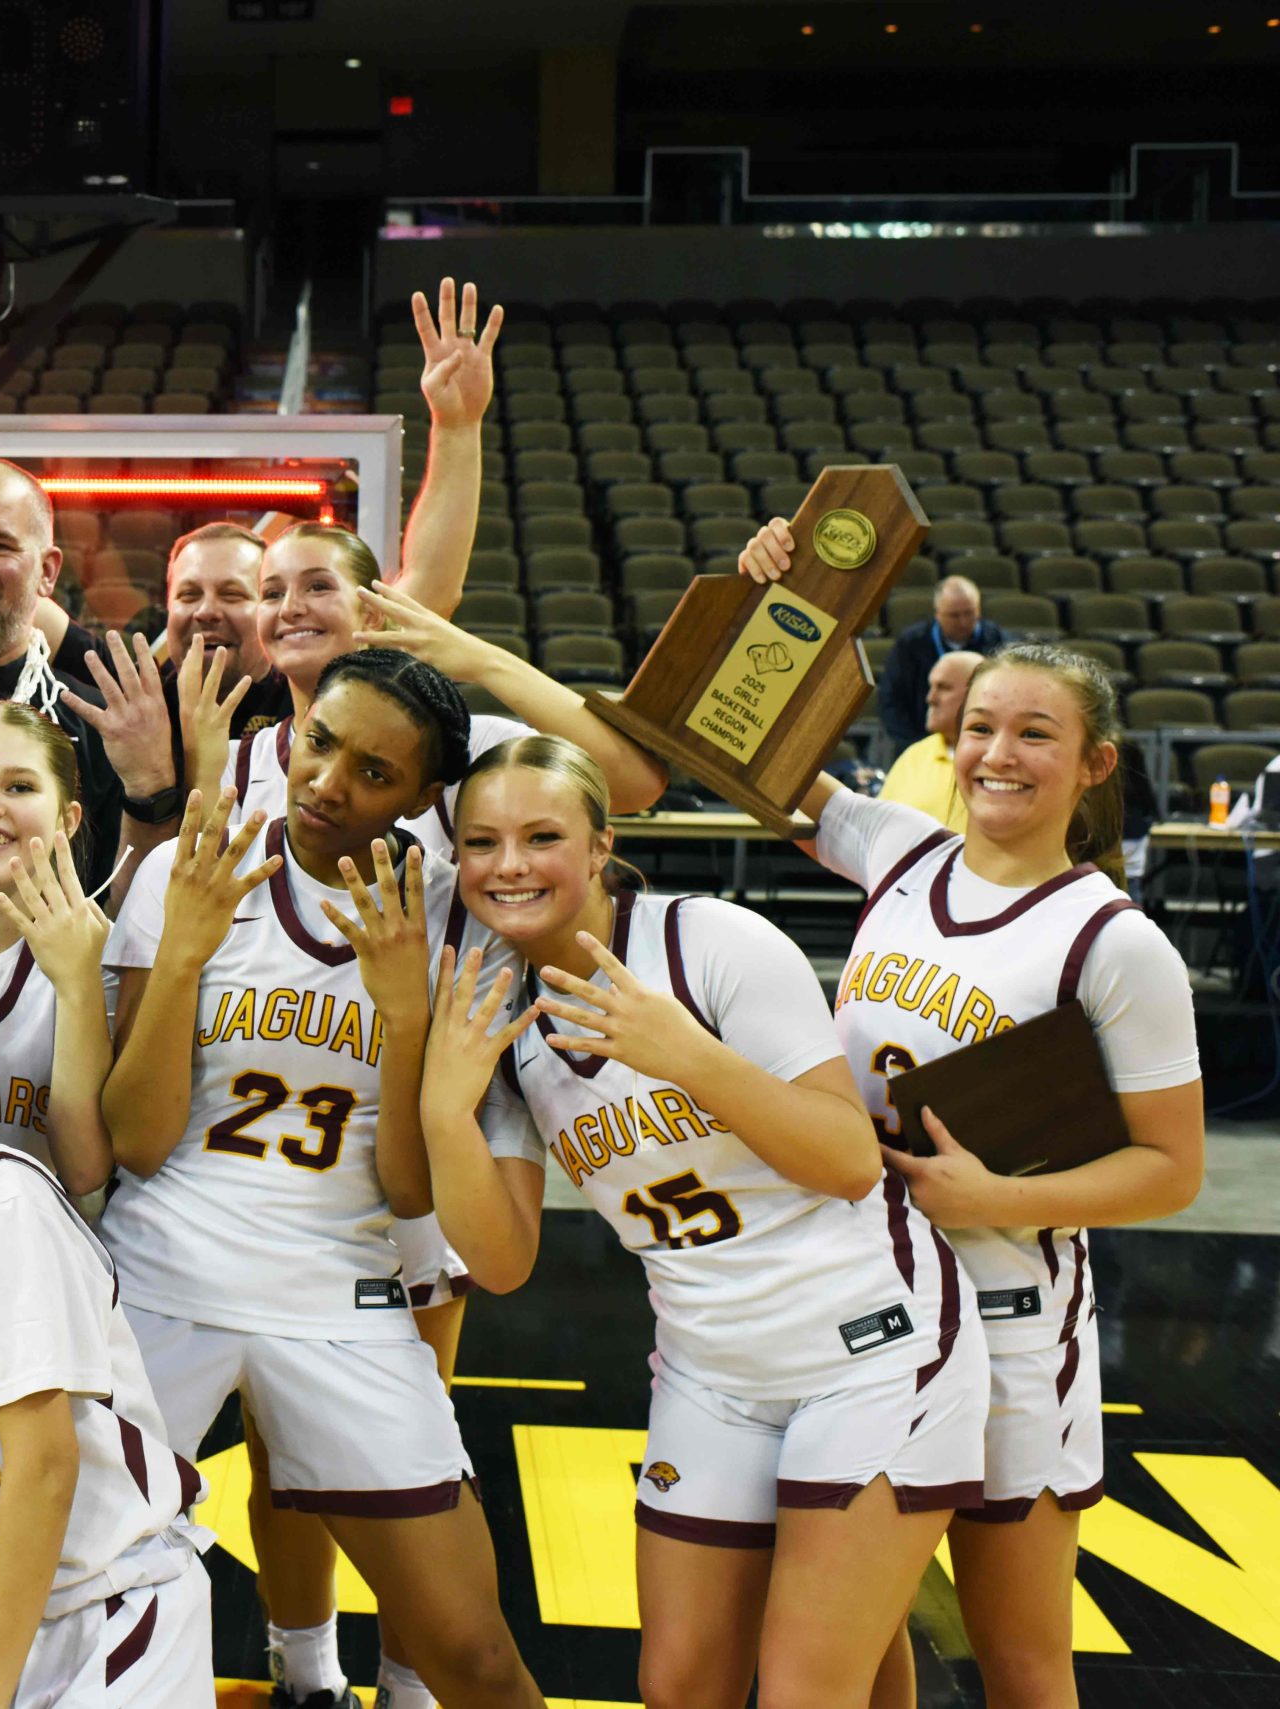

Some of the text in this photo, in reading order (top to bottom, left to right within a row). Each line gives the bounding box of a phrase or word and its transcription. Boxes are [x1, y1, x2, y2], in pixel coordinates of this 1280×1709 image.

[773, 607, 816, 638] KHSAA
[733, 685, 760, 708] GIRLS
[741, 674, 767, 694] 2025
[710, 688, 765, 729] BASKETBALL
[713, 707, 748, 735] REGION
[699, 716, 747, 751] CHAMPION
[197, 988, 384, 1068] JAGUA
[202, 1069, 360, 1173] 23
[549, 1088, 731, 1188] AGUAR
[622, 1167, 744, 1250] 15
[1022, 1297, 1031, 1309] S
[887, 1315, 902, 1330] M
